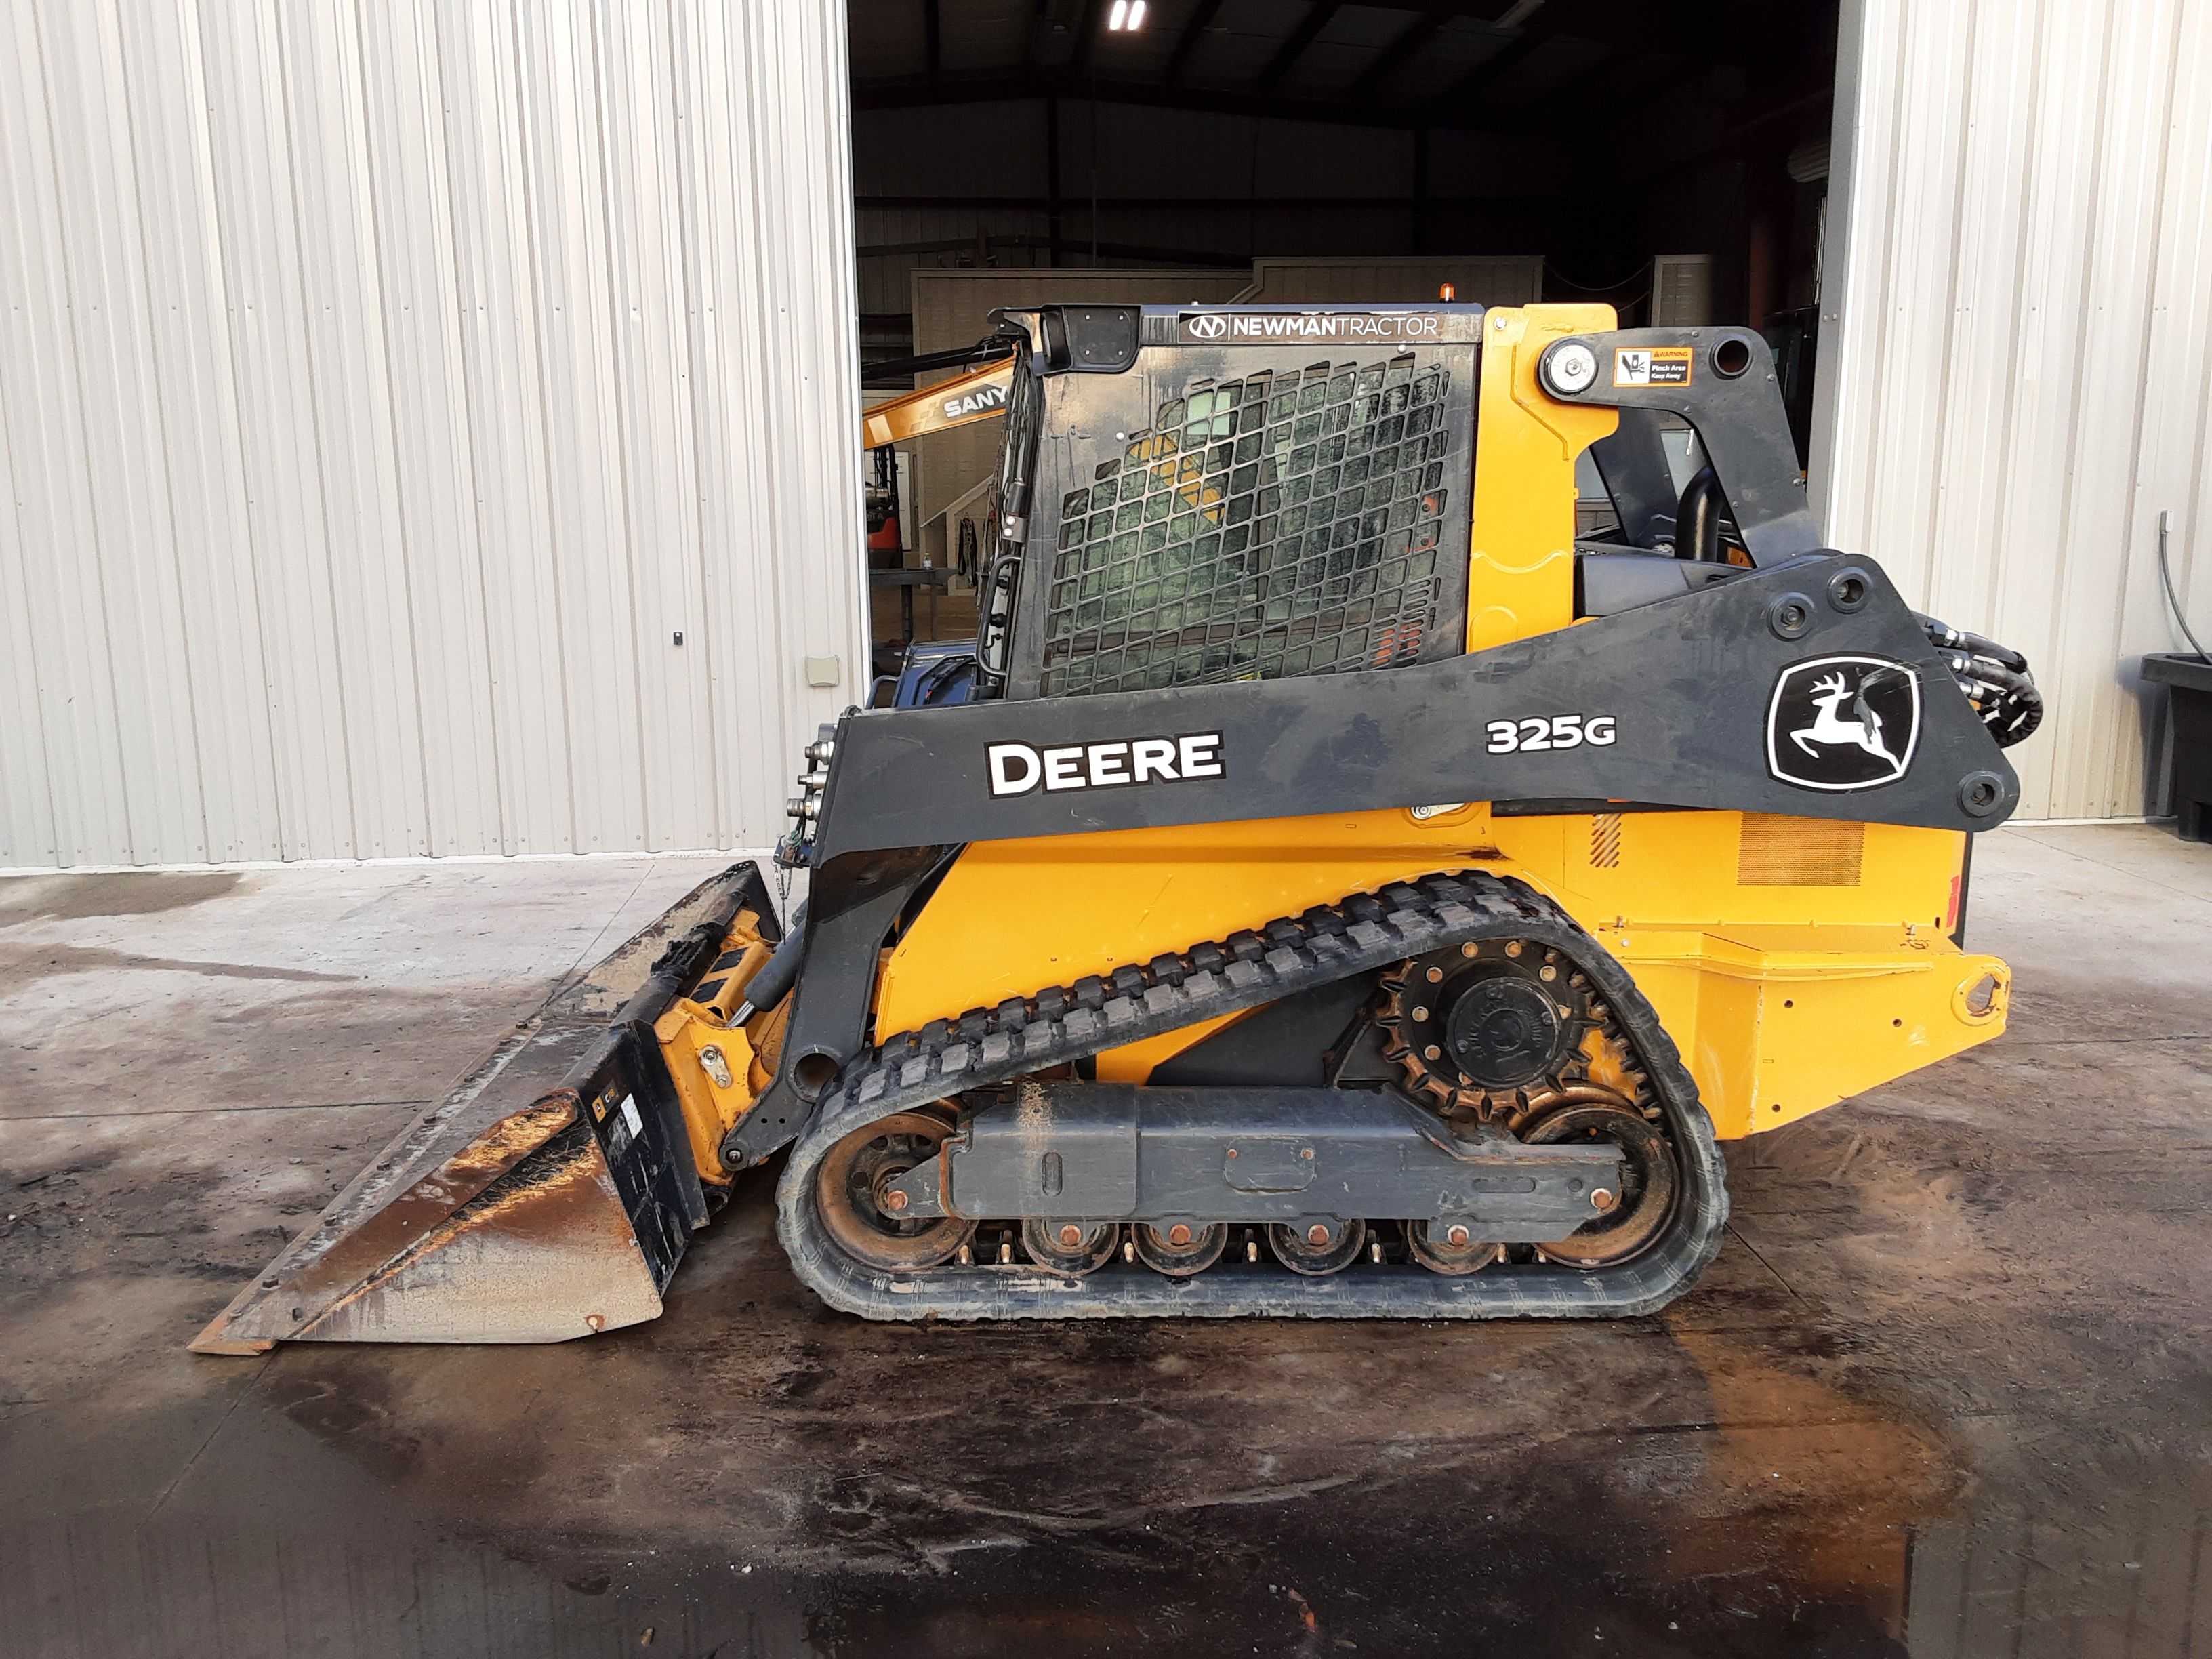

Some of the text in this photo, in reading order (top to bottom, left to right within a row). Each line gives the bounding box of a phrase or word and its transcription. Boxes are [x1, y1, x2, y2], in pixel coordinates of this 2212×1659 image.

[944, 386, 1008, 418] SANY
[1486, 715, 1617, 754] 325G
[988, 735, 1222, 795] DEERE
